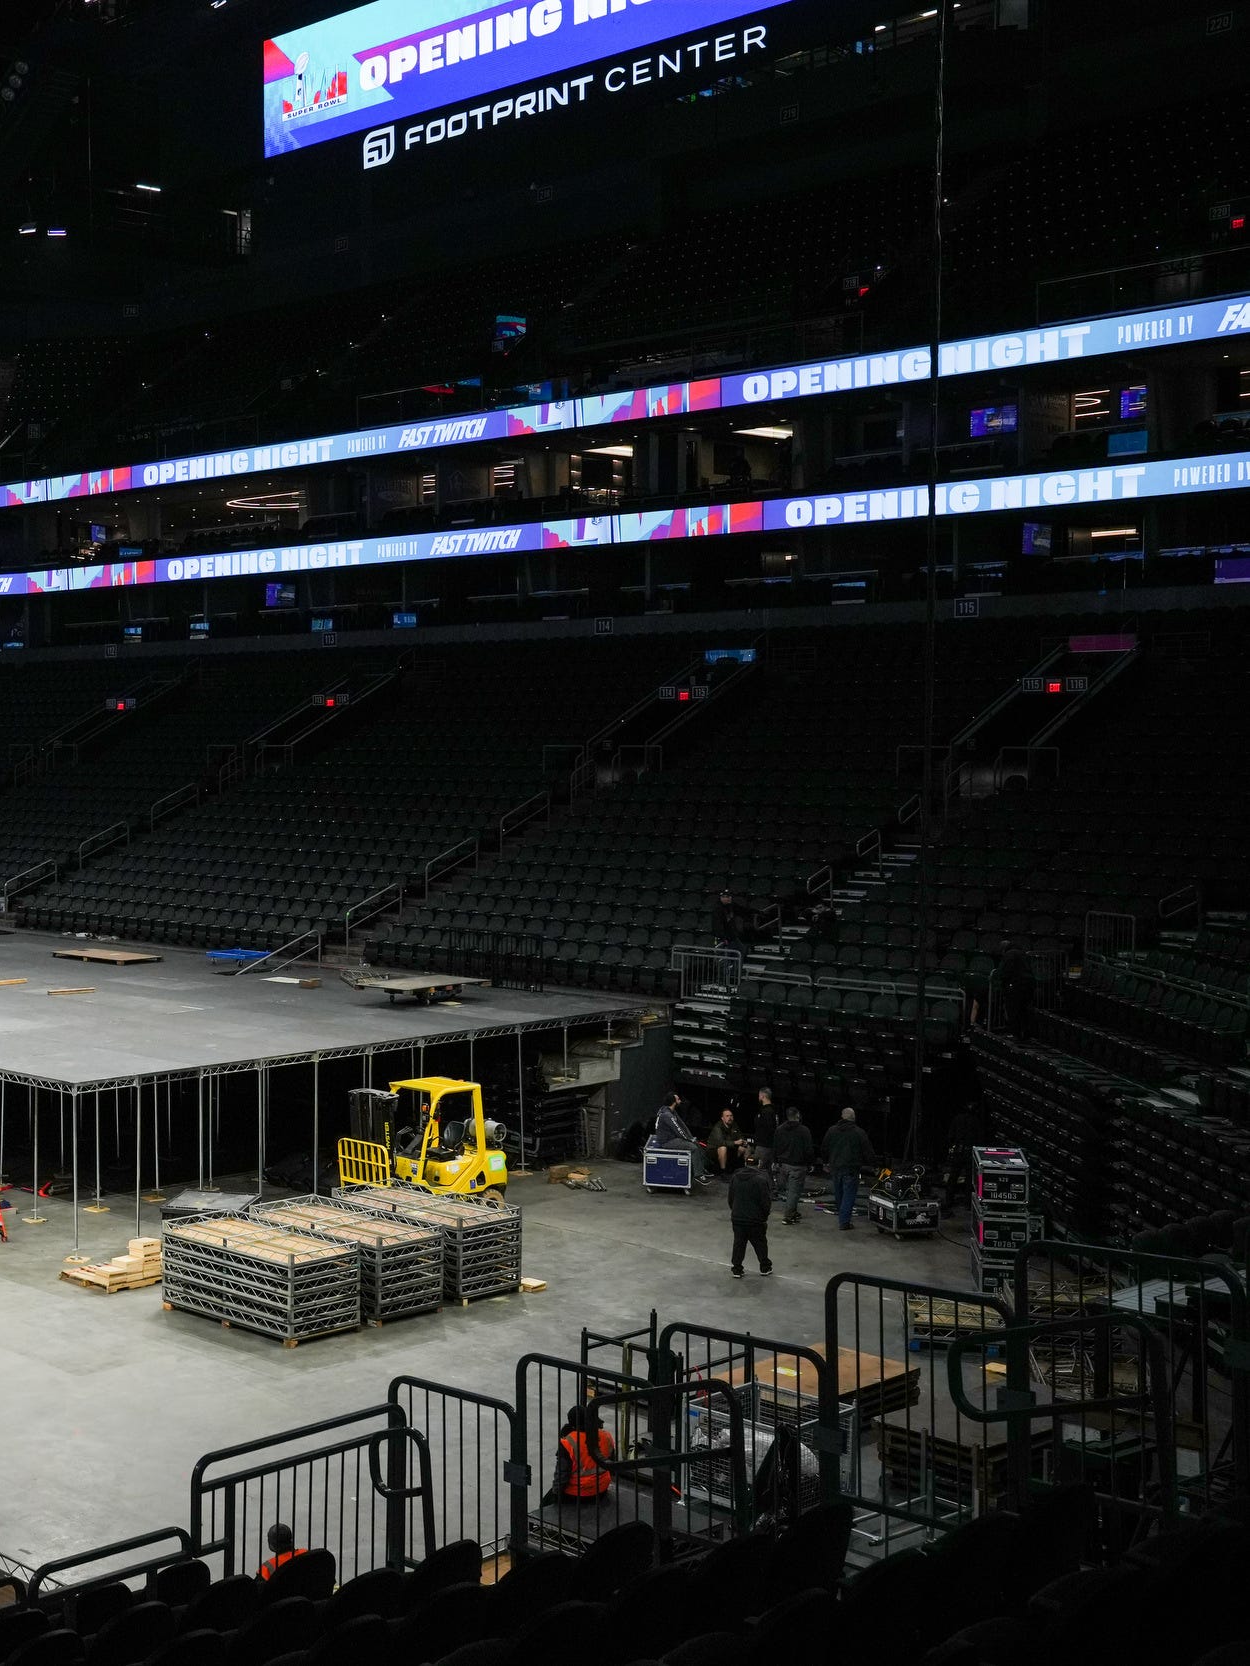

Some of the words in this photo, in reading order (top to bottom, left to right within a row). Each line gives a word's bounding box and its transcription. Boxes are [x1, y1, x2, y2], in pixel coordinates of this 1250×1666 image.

[359, 0, 564, 92] OPENING
[287, 106, 314, 119] SUPER
[318, 98, 342, 110] BOWL
[405, 76, 594, 151] FOOTPRINT
[605, 26, 766, 92] CENTER
[742, 351, 931, 402] OPENING
[940, 325, 1090, 377] NIGHT
[1118, 318, 1172, 345] POWERED
[1179, 315, 1193, 336] BY
[1217, 303, 1250, 332] FA
[143, 452, 249, 486] OPENING
[254, 439, 333, 470] NIGHT
[347, 437, 376, 453] POWERED
[378, 435, 386, 448] BY
[398, 426, 434, 448] FAST
[432, 418, 487, 444] TWITCH
[785, 483, 980, 527] OPENING
[991, 467, 1145, 510] NIGHT
[1174, 463, 1230, 487] POWERED
[167, 551, 276, 580] OPENING
[281, 543, 363, 571] NIGHT
[378, 542, 408, 558] POWERED
[410, 541, 418, 555] BY
[430, 534, 467, 556] FAST
[464, 529, 522, 553] TWITCH
[958, 601, 975, 615] 115
